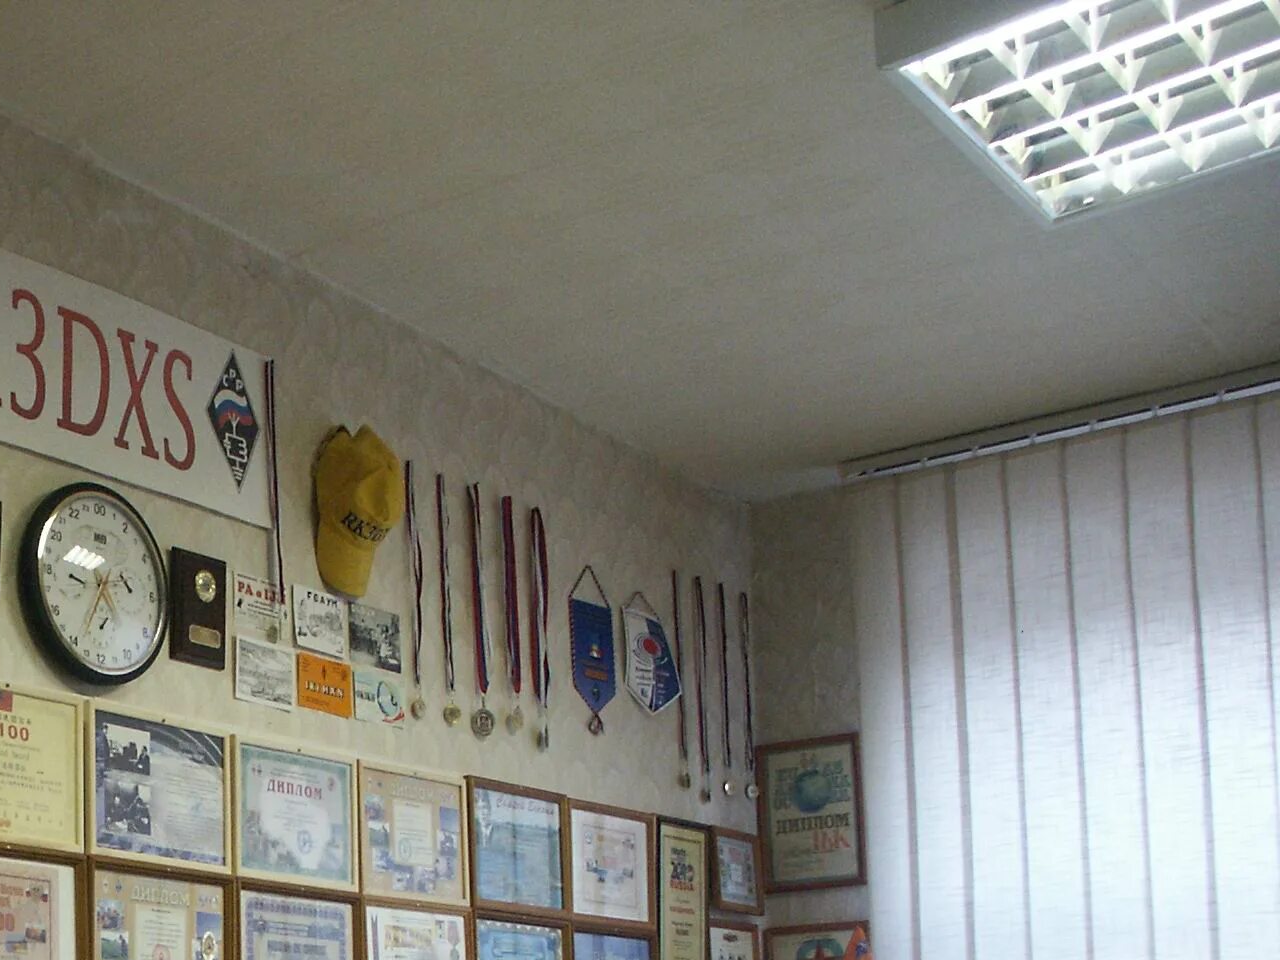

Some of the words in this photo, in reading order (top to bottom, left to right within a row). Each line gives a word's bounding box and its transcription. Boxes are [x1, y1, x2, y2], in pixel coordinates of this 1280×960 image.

[69, 507, 80, 520] 22
[94, 503, 106, 516] 00
[122, 522, 128, 534] 2
[51, 530, 62, 543] 20
[69, 635, 79, 647] 14
[96, 654, 106, 664] 12
[122, 649, 132, 661] 10
[267, 779, 323, 800] ДИПЛОМ
